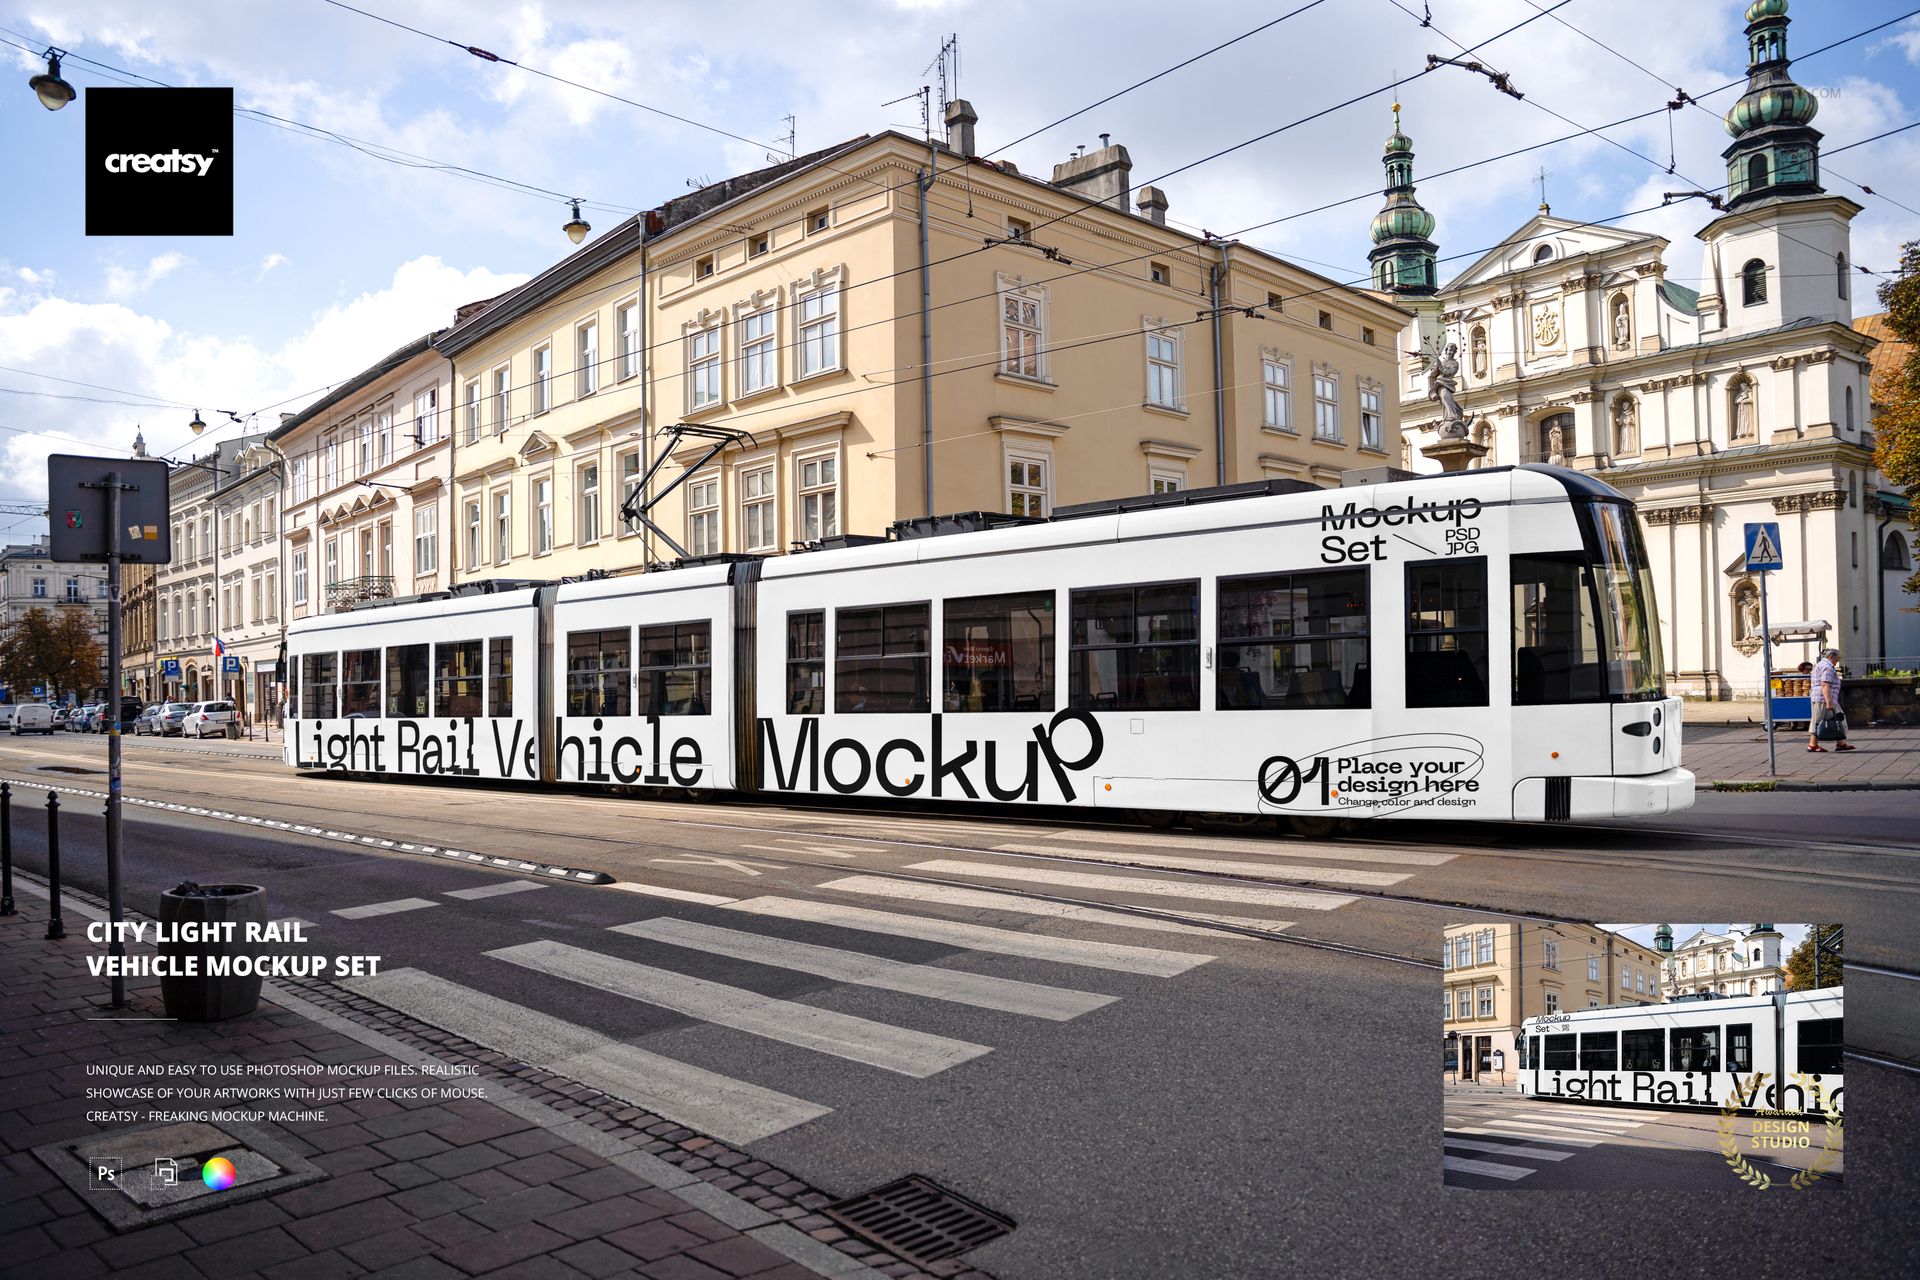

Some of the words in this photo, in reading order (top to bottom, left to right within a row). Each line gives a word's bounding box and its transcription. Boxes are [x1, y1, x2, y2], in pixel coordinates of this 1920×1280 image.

[1321, 496, 1482, 531] Mockup
[1445, 528, 1480, 542] PSD
[1321, 535, 1387, 564] Set
[1445, 541, 1479, 556] JPG
[226, 658, 236, 671] P
[295, 718, 386, 771] Light
[398, 717, 480, 776] Rail
[757, 707, 1104, 803] Mockup
[1337, 757, 1403, 774] Place
[1409, 761, 1465, 777] your
[1337, 776, 1419, 796] design
[1425, 776, 1480, 793] here
[1338, 797, 1379, 807] Change
[1381, 797, 1411, 806] color
[1414, 797, 1435, 806] and
[1437, 797, 1476, 807] design
[1535, 1024, 1550, 1033] Set
[1535, 1069, 1622, 1099] Light
[1633, 1070, 1718, 1106] Rail
